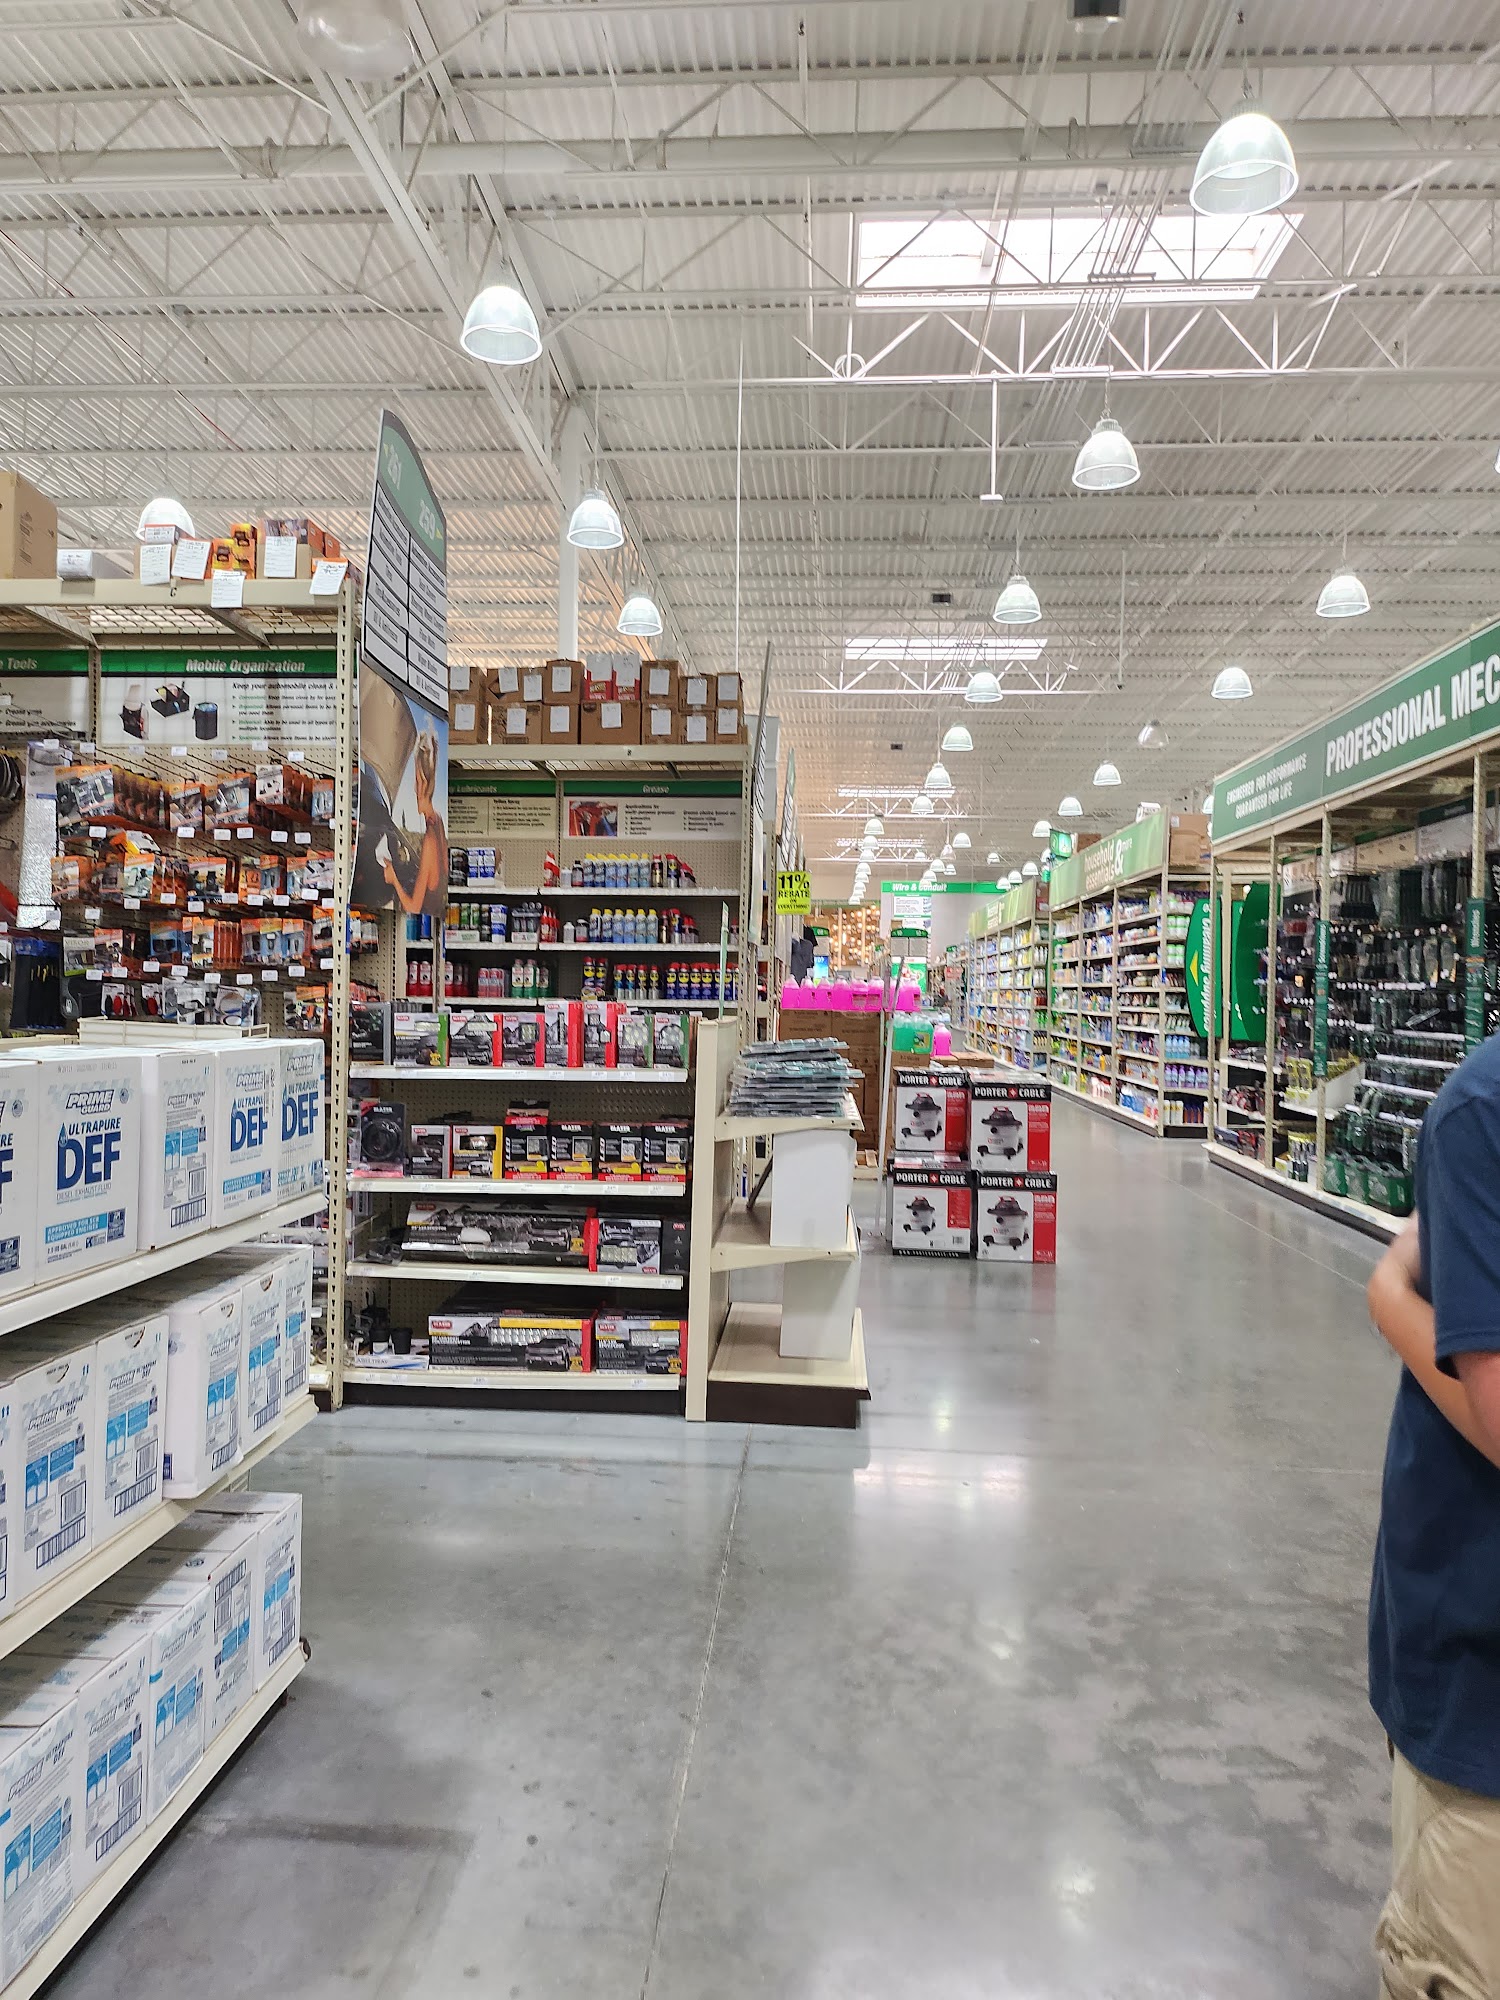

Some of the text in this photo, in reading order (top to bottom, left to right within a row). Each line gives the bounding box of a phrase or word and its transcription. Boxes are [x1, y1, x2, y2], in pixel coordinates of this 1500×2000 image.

[7, 657, 38, 670] Tools
[186, 658, 306, 674] Mobile Organization
[268, 682, 306, 690] automobile
[1326, 653, 1500, 777] PROFESSIONAL MEC
[1226, 752, 1307, 806] ENGINEERED FOR PERFORMANCE
[456, 784, 498, 794] Lubricants
[642, 785, 670, 794] Grease
[1236, 780, 1292, 820] GUARANTEED FOR LIFE
[1084, 838, 1114, 872] household
[1114, 839, 1124, 876] &
[778, 874, 810, 888] 11%
[1086, 864, 1114, 892] essentials
[778, 890, 810, 898] REBATE
[892, 883, 909, 892] Wire
[918, 883, 948, 892] Conduit
[287, 1054, 314, 1071] PRIME
[236, 1071, 263, 1088] PRIME
[288, 1078, 318, 1094] ULTRAPURE
[900, 1074, 964, 1086] PORTER CABLE
[66, 1089, 114, 1110] PRIME
[974, 1087, 1046, 1098] PORTER CABLE
[81, 1102, 112, 1114] GUARD
[282, 1092, 318, 1142] DEF
[68, 1118, 121, 1136] ULTRAPURE
[56, 1131, 121, 1191] DEF
[896, 1173, 966, 1185] PORTER CABLE
[980, 1176, 1052, 1188] PORTER CABLE
